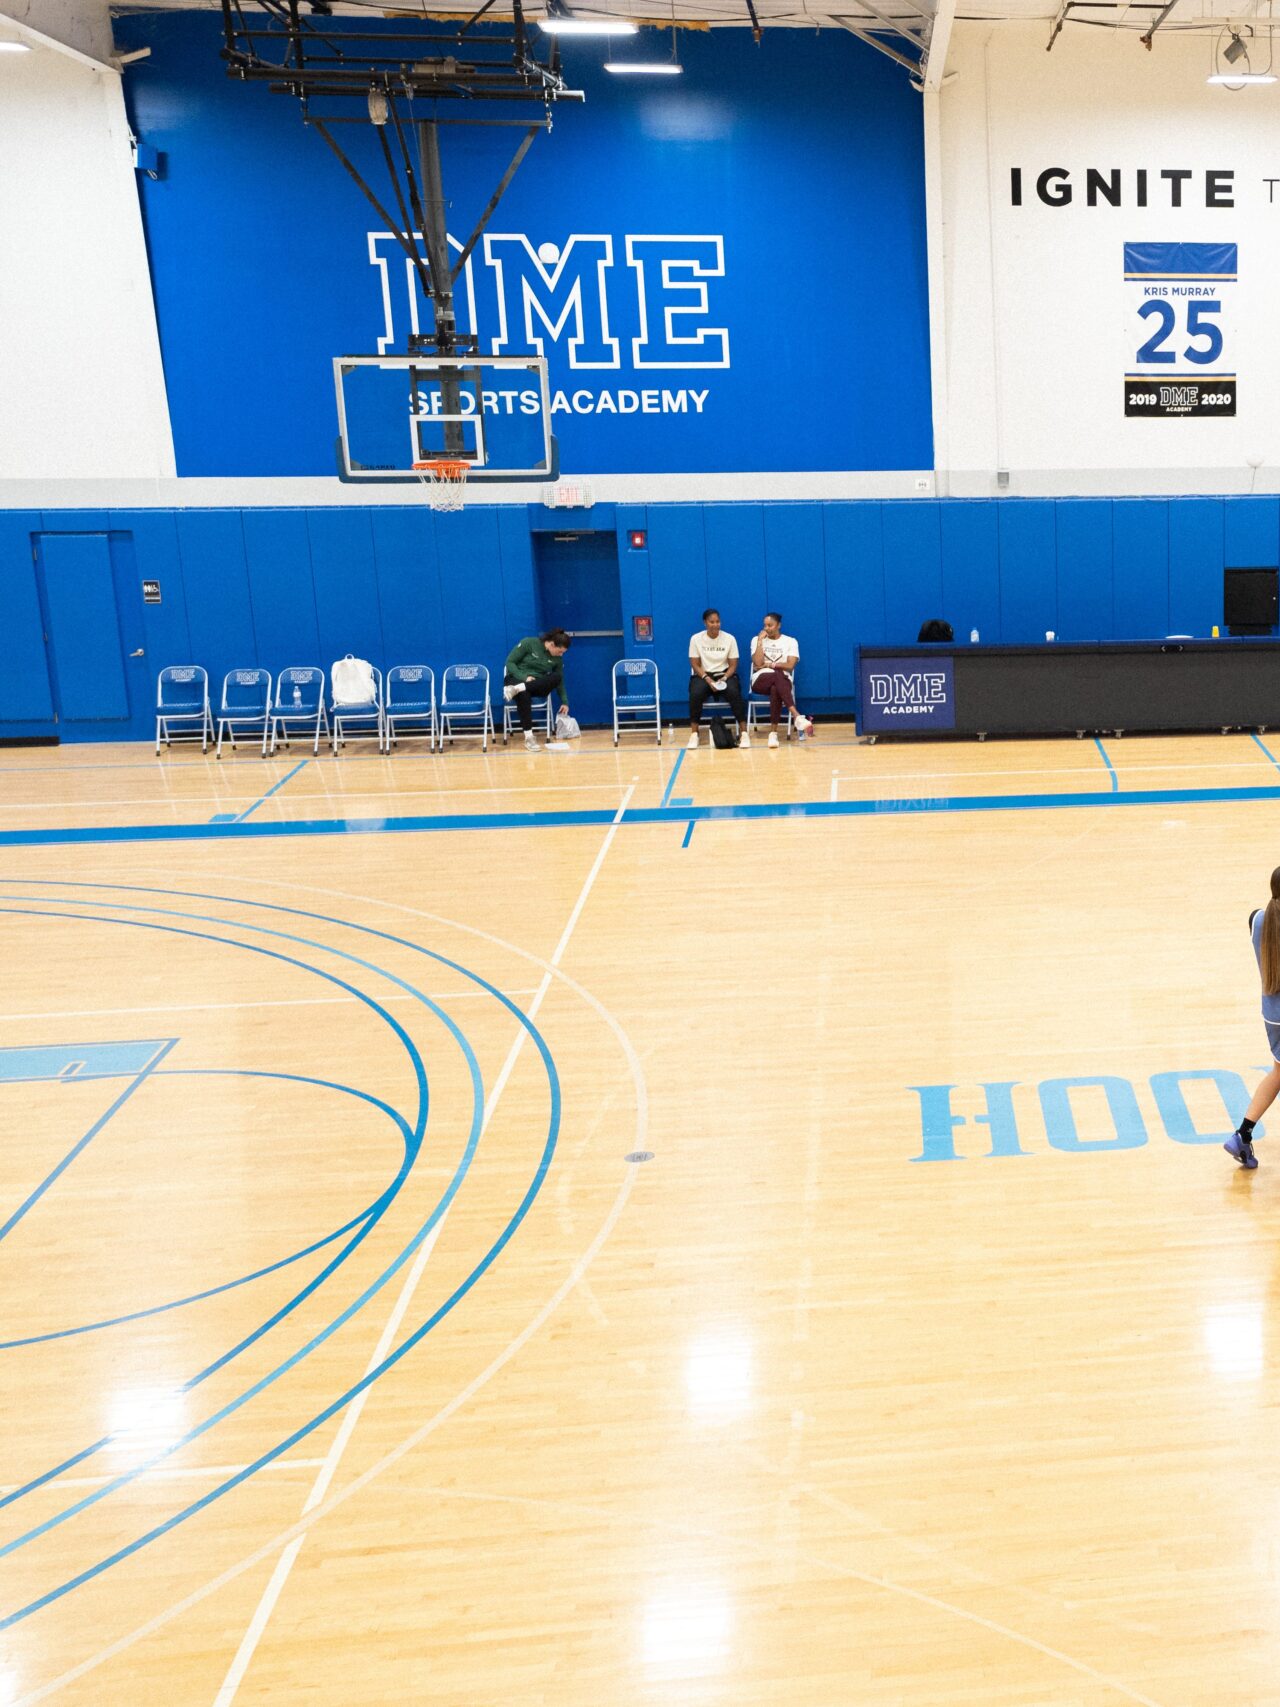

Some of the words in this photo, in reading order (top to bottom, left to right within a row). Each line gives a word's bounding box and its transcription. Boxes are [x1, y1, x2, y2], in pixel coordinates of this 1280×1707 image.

[1010, 168, 1236, 208] IGNITE
[367, 231, 731, 370] DME
[1144, 287, 1168, 296] KRIS
[1172, 287, 1216, 296] MURRAY
[1136, 299, 1223, 365] 25
[550, 389, 709, 414] ACADEMY
[1129, 393, 1157, 406] 2019
[1160, 386, 1199, 406] DME
[1201, 393, 1232, 406] 2020
[870, 673, 946, 705] DME
[883, 706, 934, 714] ACADEMY
